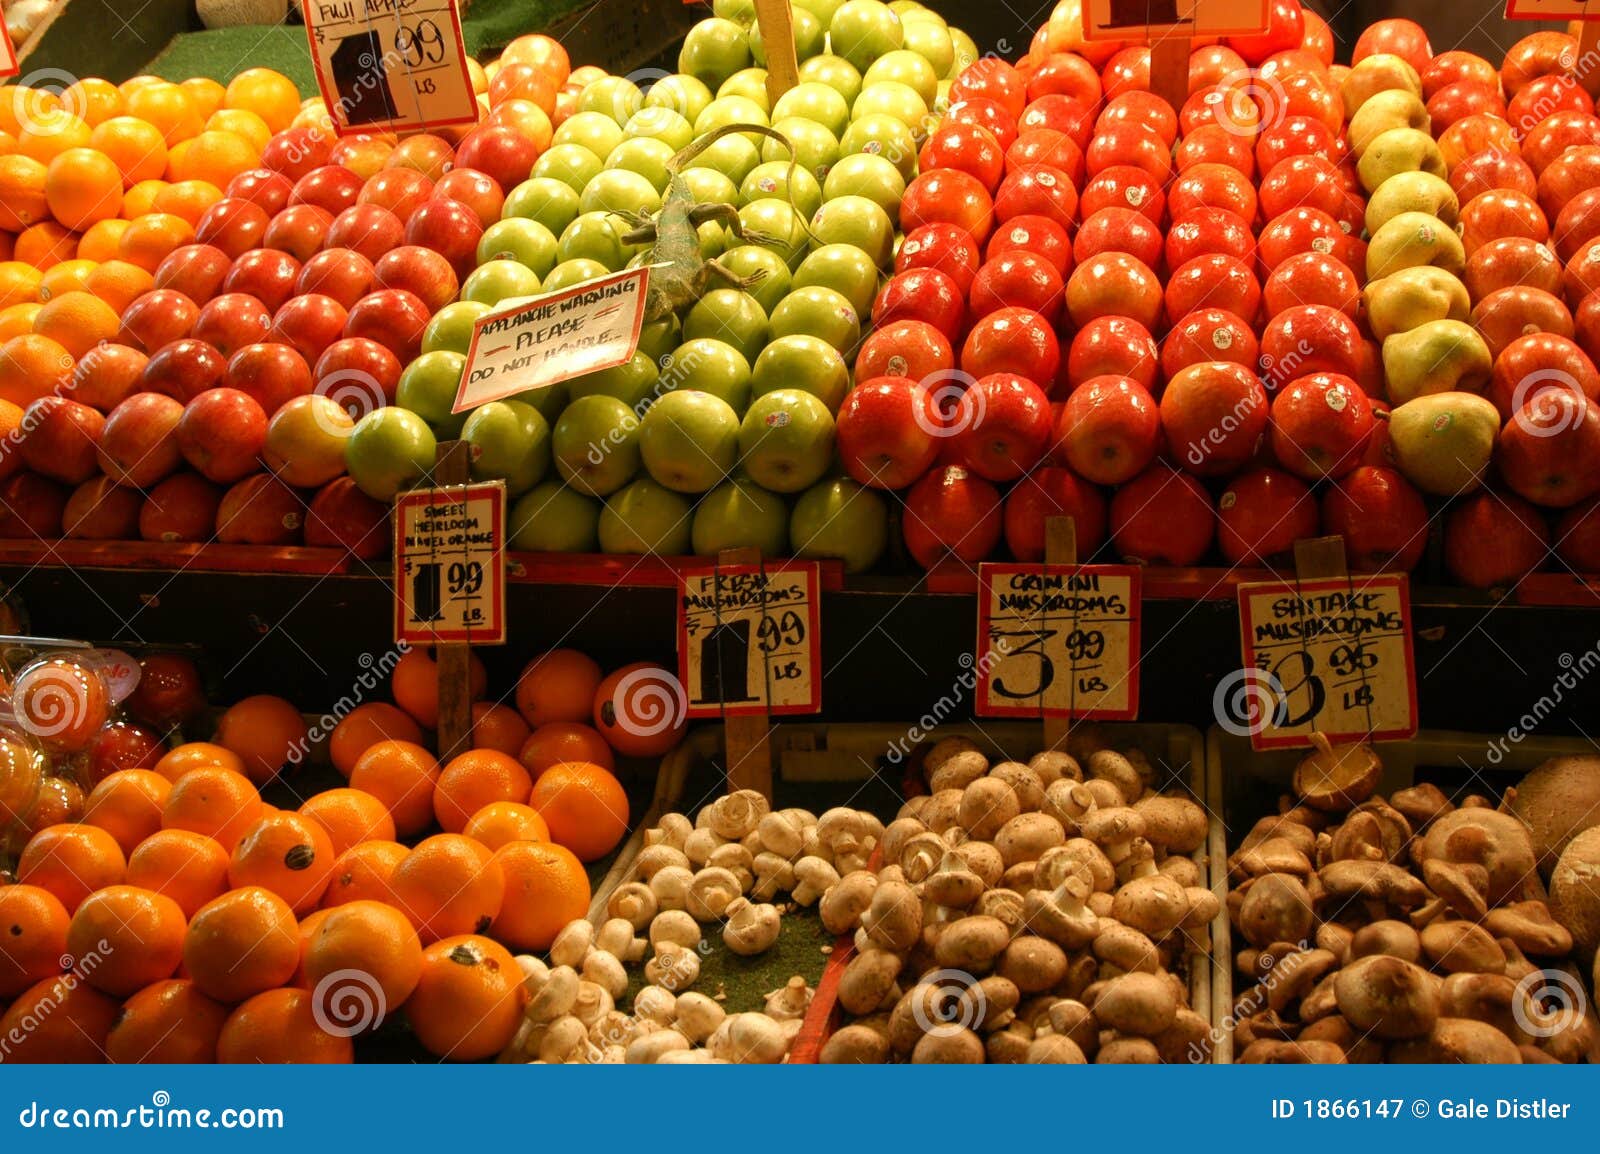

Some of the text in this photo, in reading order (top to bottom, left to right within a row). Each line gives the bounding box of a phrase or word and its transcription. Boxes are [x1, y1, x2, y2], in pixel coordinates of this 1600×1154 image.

[319, 2, 355, 22] FUJI
[395, 18, 445, 68] 99
[414, 78, 437, 96] LB
[478, 281, 636, 338] APPLANCHE WARNING
[515, 314, 587, 351] PLEASE
[469, 366, 496, 385] DO
[501, 353, 537, 375] NOT
[423, 504, 466, 519] SWEET
[405, 531, 495, 547] NAVEL ORANGE
[414, 518, 479, 534] HEIRLOOM
[447, 561, 484, 594] 99
[700, 573, 770, 593] FRESH
[682, 584, 805, 610] MUSHROOMS
[999, 593, 1127, 615] MUSHROOMS
[1271, 592, 1386, 619] SHITAKE
[756, 610, 805, 652] 99
[1254, 611, 1404, 642] MUSHROOMS
[1064, 629, 1105, 661] 99
[1328, 641, 1379, 676] 95
[774, 661, 801, 681] LB
[1079, 676, 1109, 694] LB
[1343, 684, 1375, 711] LB
